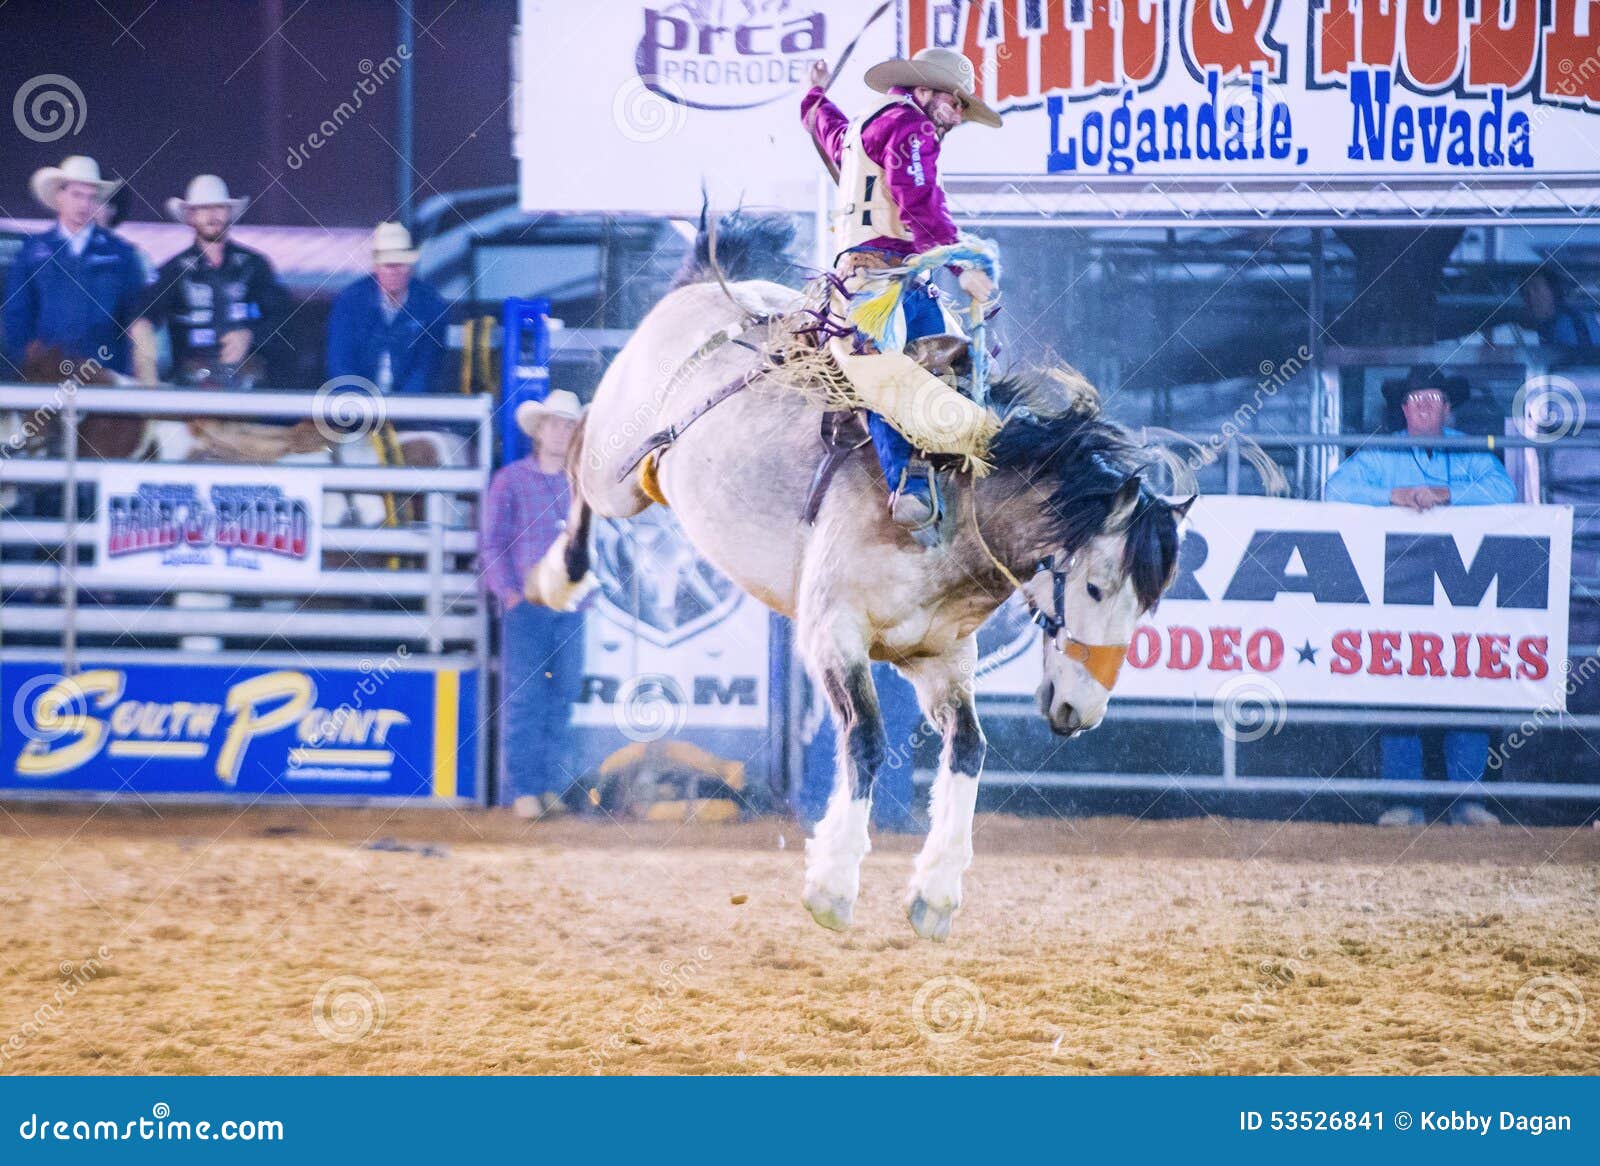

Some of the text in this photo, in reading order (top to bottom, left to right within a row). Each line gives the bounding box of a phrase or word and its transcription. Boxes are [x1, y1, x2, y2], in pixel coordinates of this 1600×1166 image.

[637, 8, 826, 84] prca
[664, 59, 816, 84] PRORODE
[1047, 71, 1534, 174] Logandale, Nevada
[1125, 625, 1549, 681] ODEO SERIES
[578, 675, 760, 705] RAM
